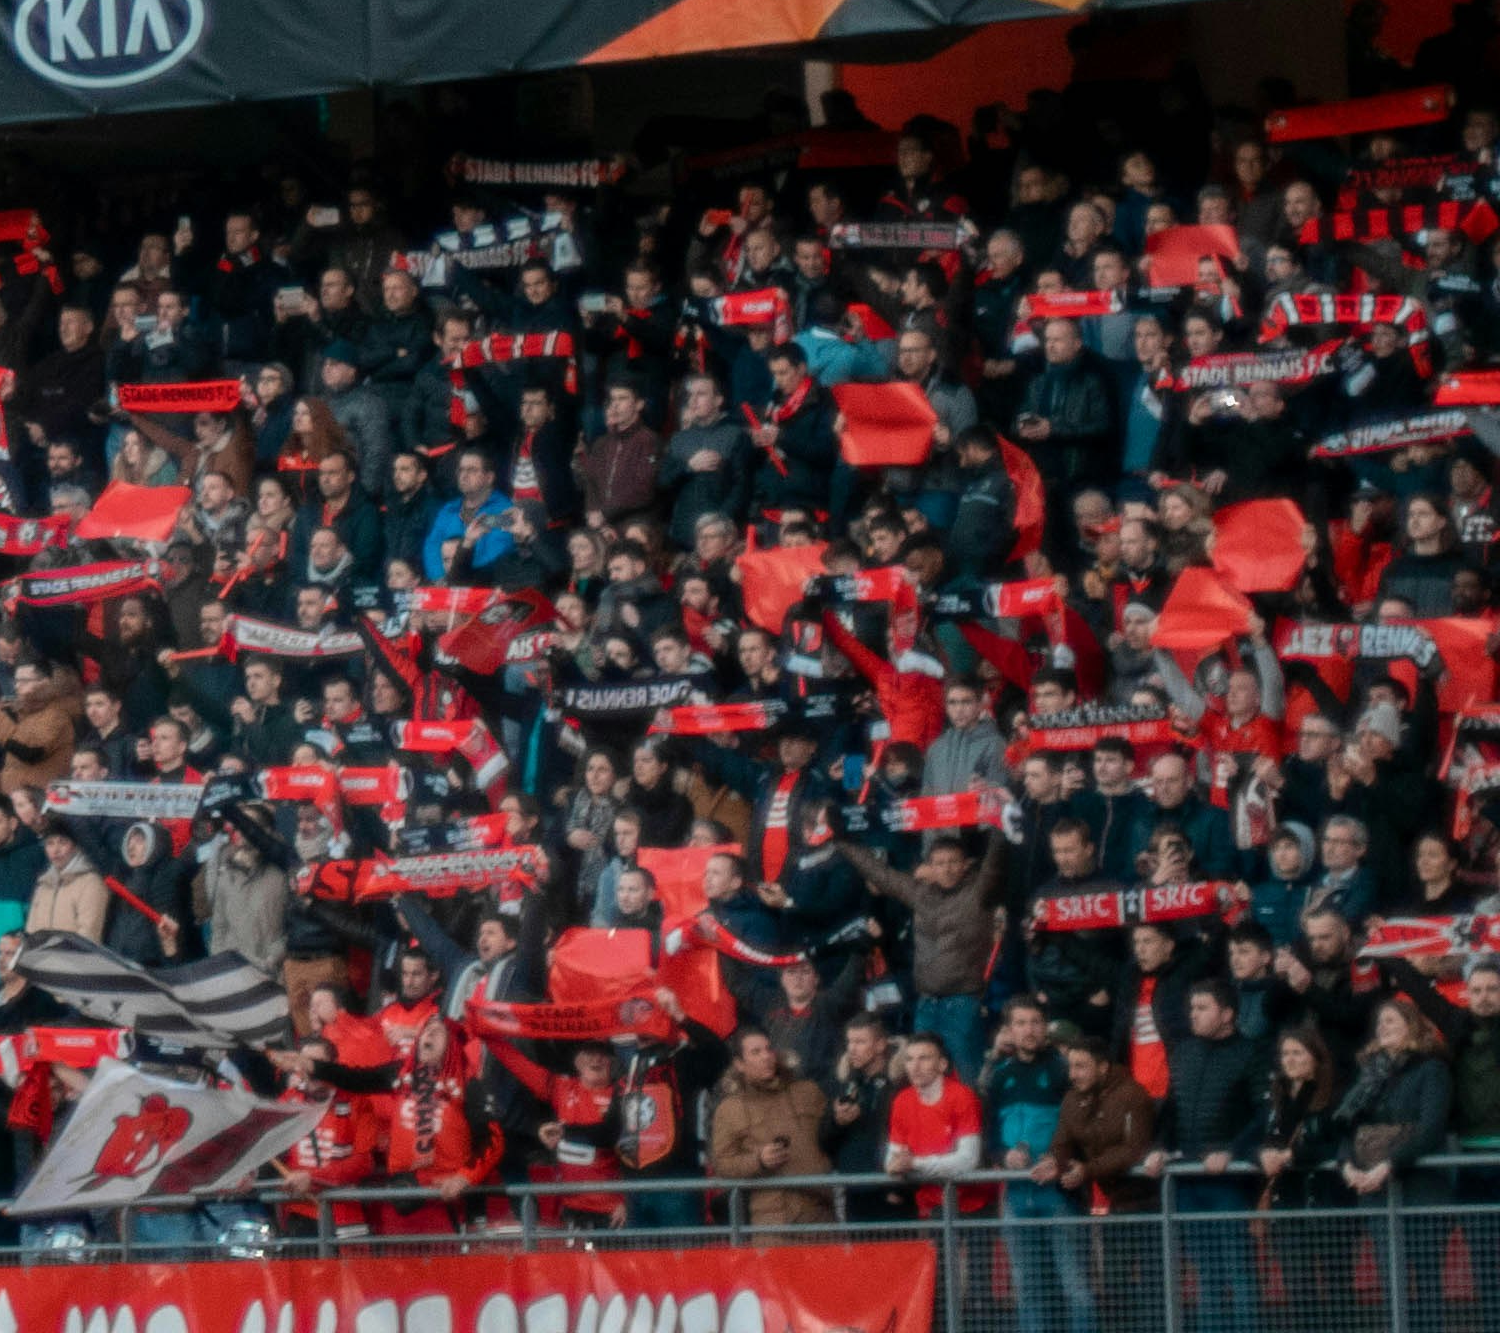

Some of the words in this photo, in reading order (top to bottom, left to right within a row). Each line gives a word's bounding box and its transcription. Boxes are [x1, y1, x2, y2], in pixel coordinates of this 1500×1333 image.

[1180, 361, 1233, 387] STADE
[1235, 357, 1304, 384] RENNAIS
[122, 387, 161, 404] STADE
[162, 386, 213, 403] RENNAIS
[1360, 623, 1439, 668] RENNES
[1030, 707, 1082, 729] STADE
[1084, 702, 1167, 723] RENNAIS
